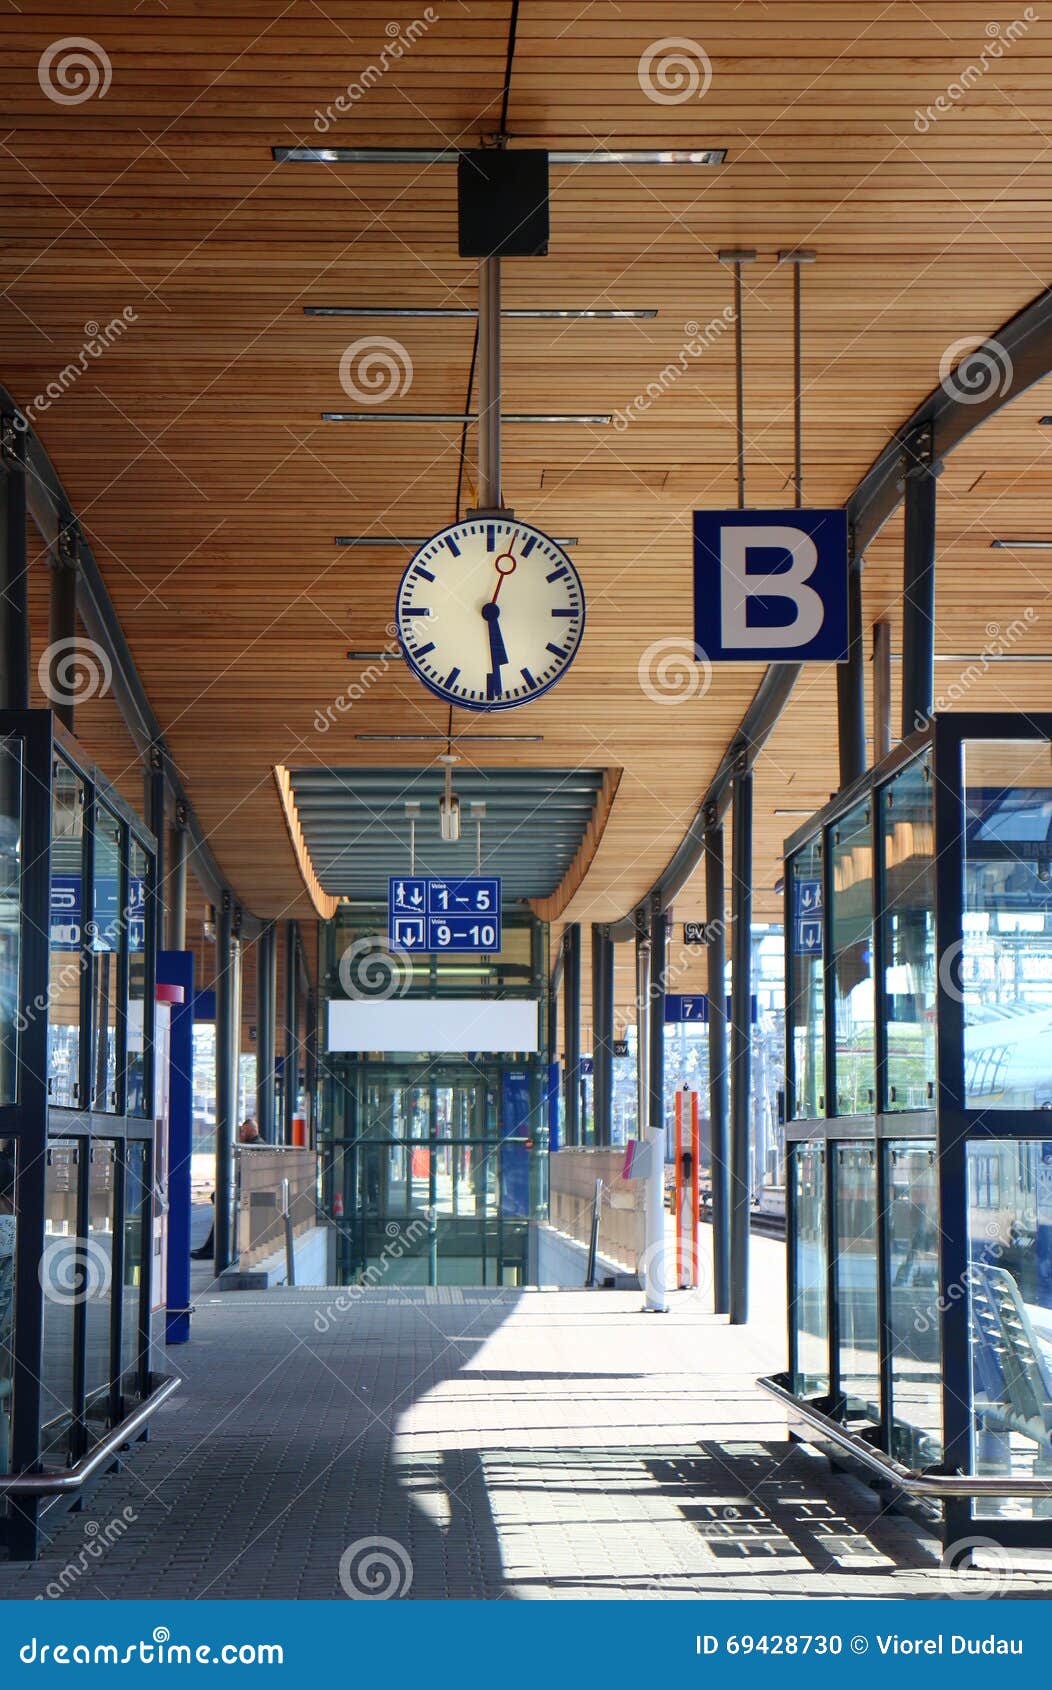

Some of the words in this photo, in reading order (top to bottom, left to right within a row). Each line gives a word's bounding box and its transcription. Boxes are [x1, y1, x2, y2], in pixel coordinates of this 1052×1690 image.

[720, 525, 825, 650] B
[683, 1003, 693, 1018] 7
[584, 1063, 590, 1072] 7
